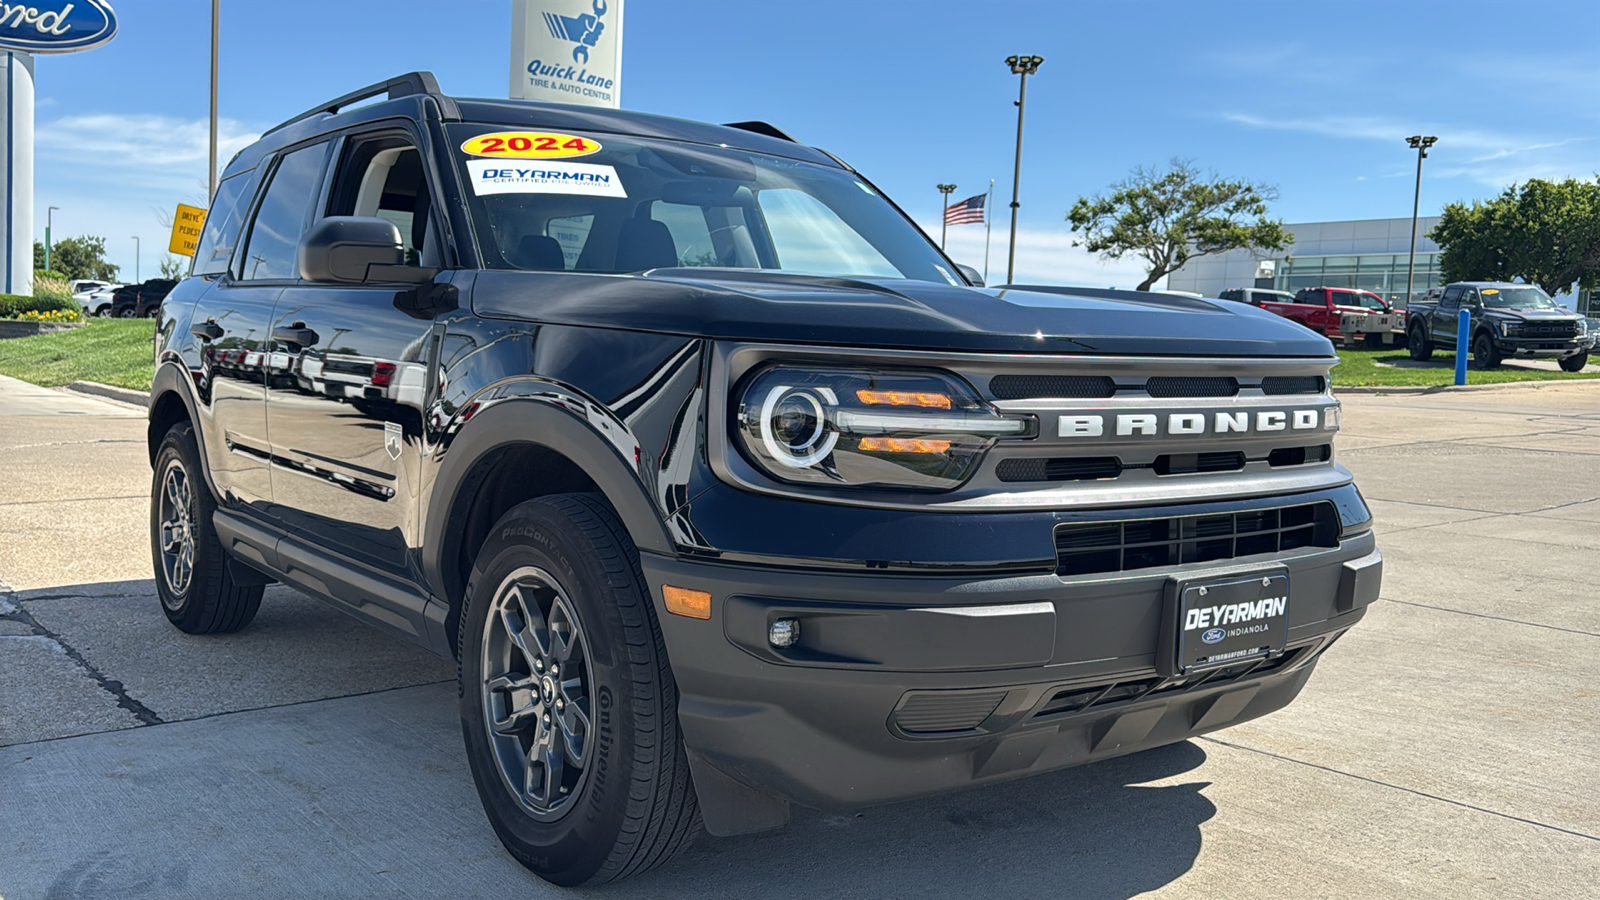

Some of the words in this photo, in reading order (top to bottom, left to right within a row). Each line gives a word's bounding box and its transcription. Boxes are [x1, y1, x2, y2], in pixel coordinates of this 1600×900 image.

[0, 3, 75, 35] ord
[527, 59, 576, 81] Quick
[577, 69, 613, 89] Lane
[529, 77, 549, 89] TIRE
[551, 81, 557, 90] &
[558, 83, 581, 94] AUTO
[582, 88, 611, 101] CENTER
[480, 137, 588, 153] 2024
[482, 169, 610, 183] DEYARMAN
[551, 179, 610, 188] PRE-OWNED
[1058, 410, 1318, 437] BRONCO
[1184, 596, 1287, 631] DEYARMAN
[1206, 629, 1222, 641] Ford
[1227, 623, 1269, 637] INDIANOLA
